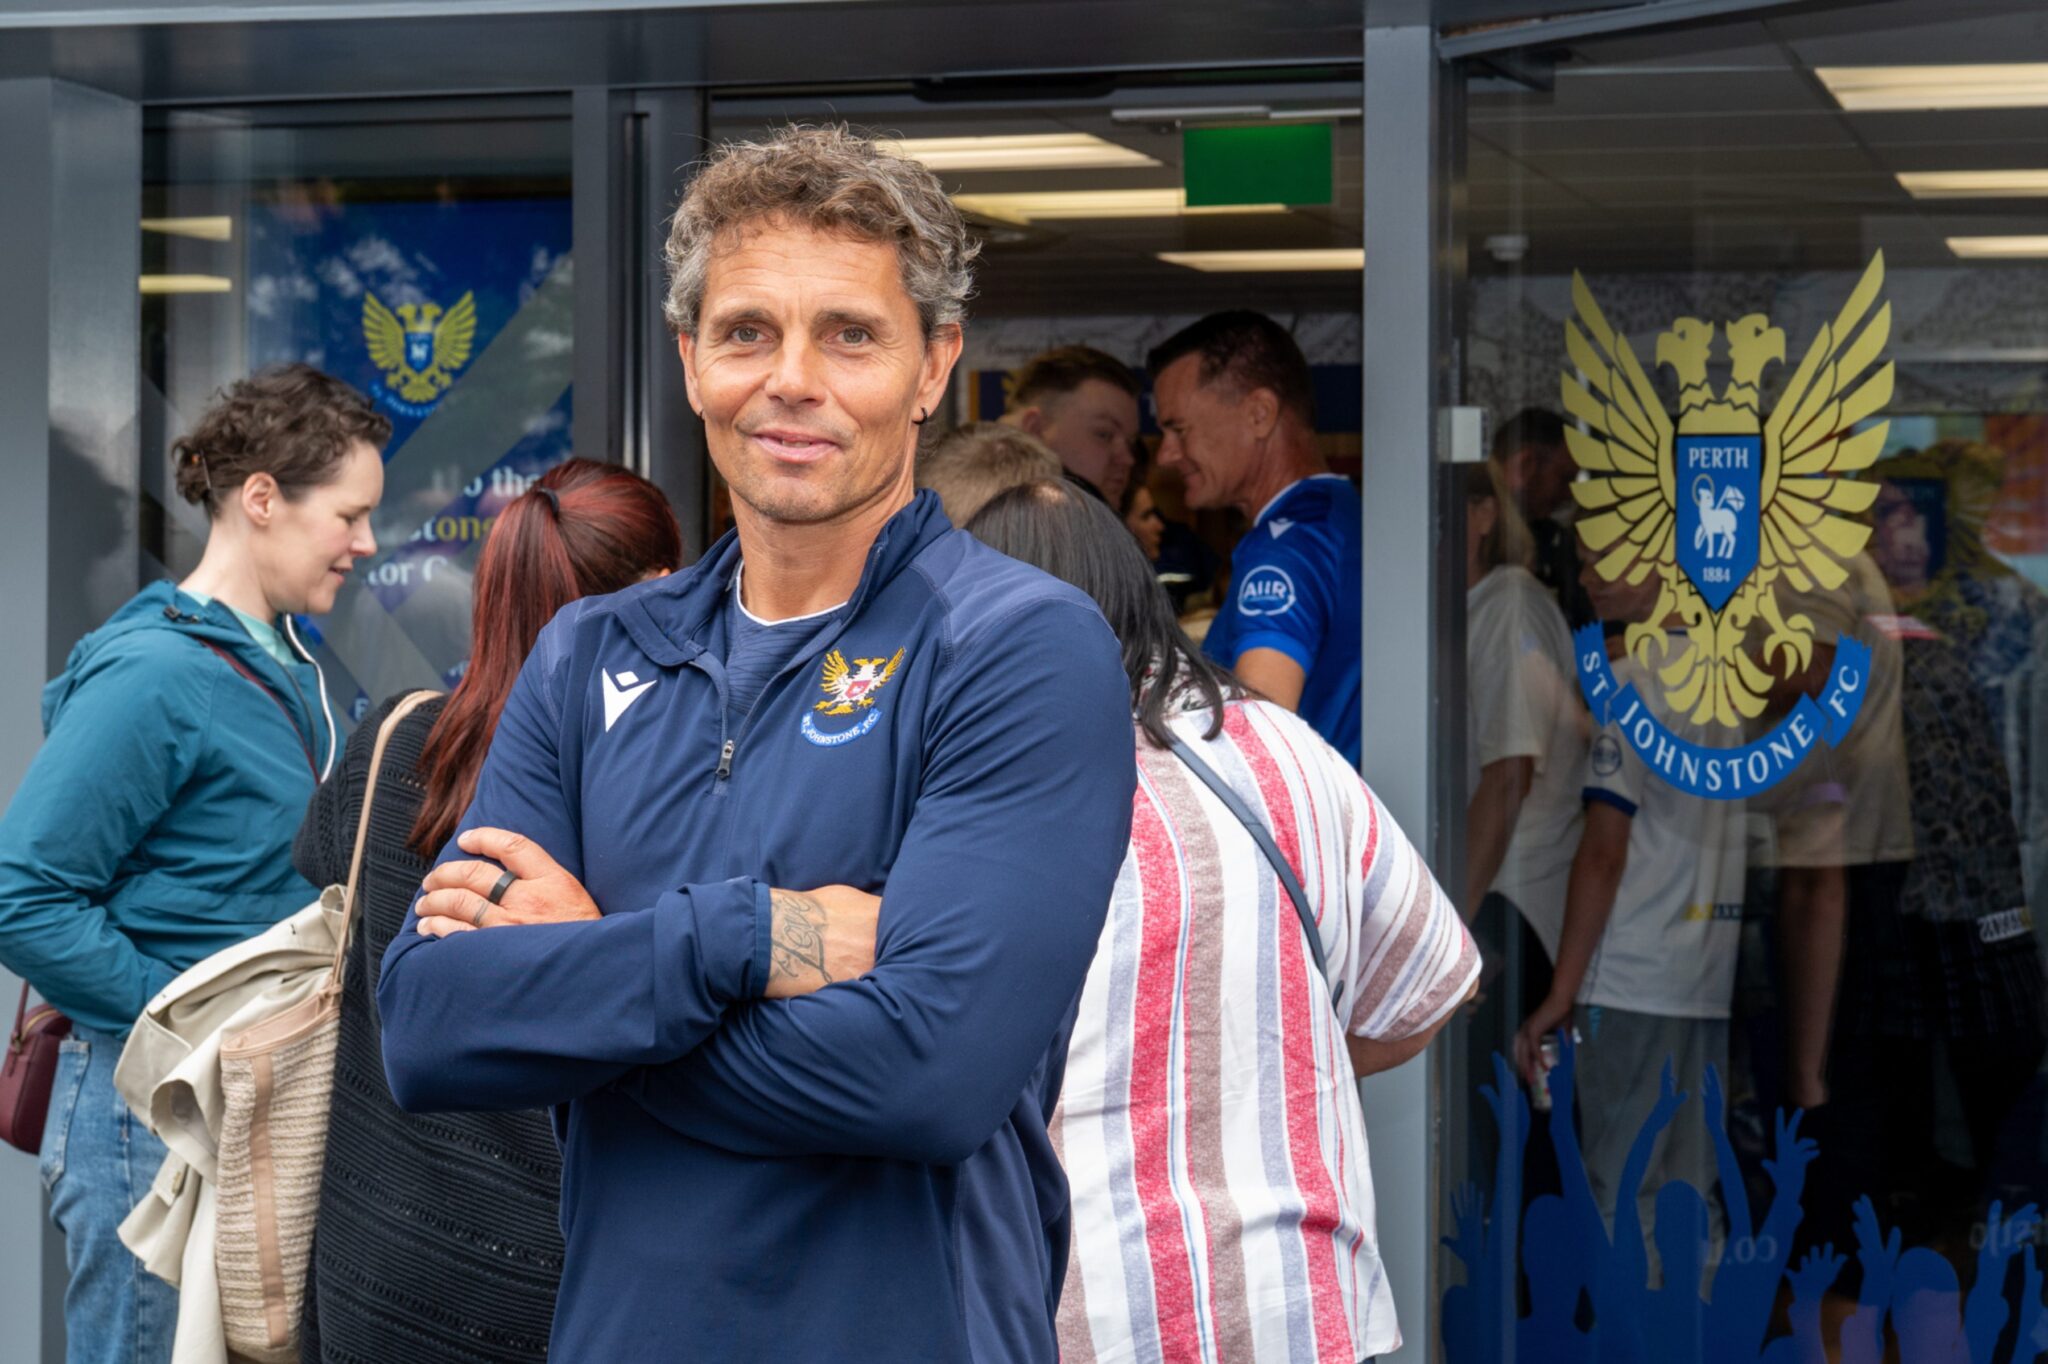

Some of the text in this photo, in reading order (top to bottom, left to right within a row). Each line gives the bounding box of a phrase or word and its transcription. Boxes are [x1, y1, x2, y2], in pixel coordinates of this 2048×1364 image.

[1689, 447, 1749, 469] PERTH
[1703, 567, 1731, 583] 1884
[1583, 651, 1860, 792] ST JOHNSTONE FC
